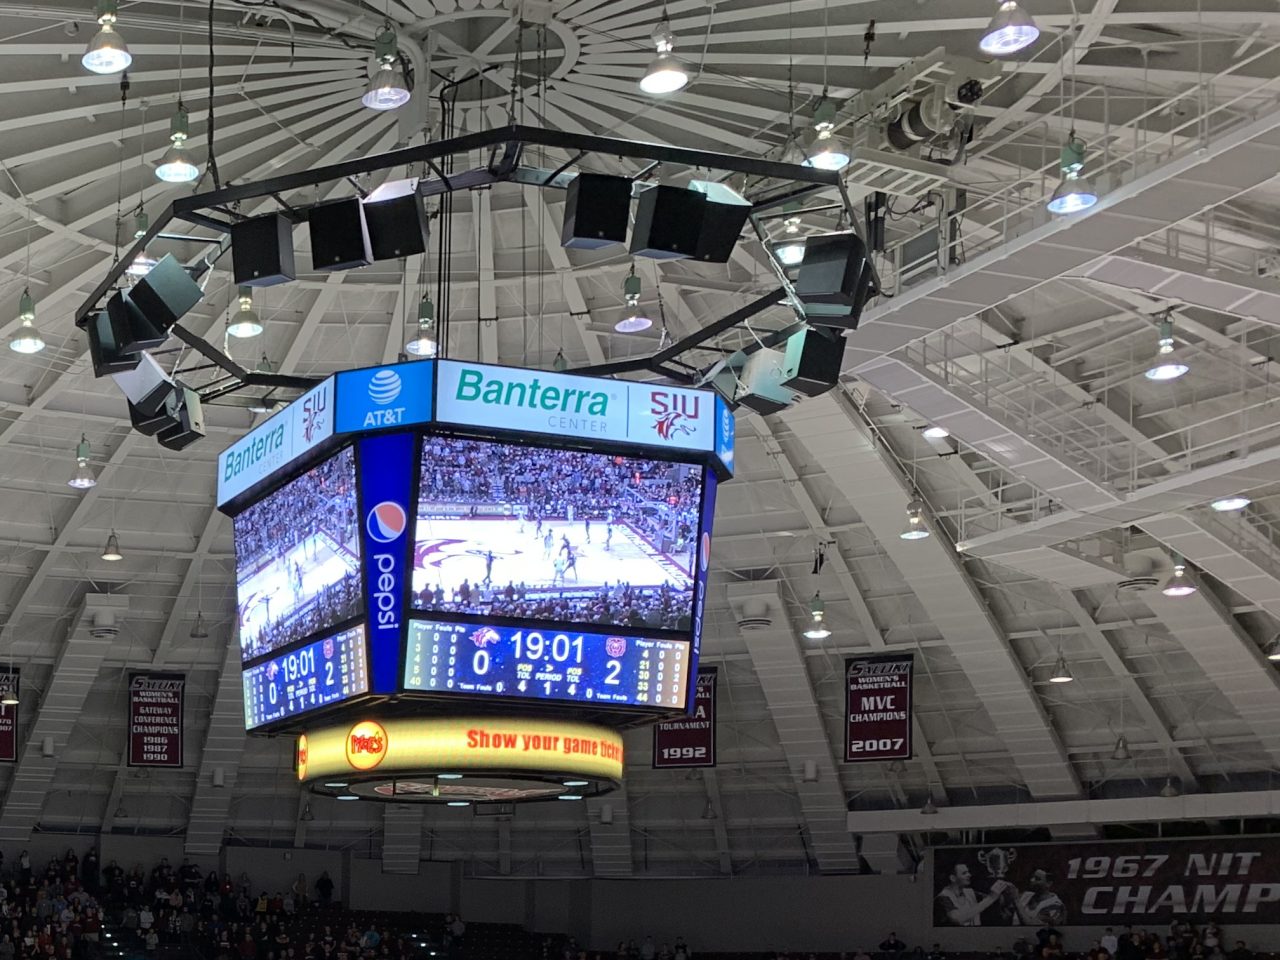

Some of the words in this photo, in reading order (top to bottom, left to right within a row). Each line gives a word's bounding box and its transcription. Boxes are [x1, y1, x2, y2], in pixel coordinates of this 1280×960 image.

[303, 386, 327, 414] SIU
[456, 368, 609, 417] Banterra
[650, 391, 699, 419] SIU
[363, 408, 407, 428] AT&T
[547, 416, 608, 433] CENTER
[224, 424, 284, 483] Banterra
[373, 554, 399, 630] pepsi
[510, 631, 584, 663] 19:01
[635, 640, 654, 648] Player
[282, 647, 315, 683] 19:01
[473, 650, 489, 675] 0
[325, 661, 334, 686] 2
[535, 672, 562, 682] PERIOD
[604, 660, 621, 685] 2
[858, 675, 899, 683] WOMEN'S
[269, 682, 277, 705] 0
[517, 680, 526, 692] 4
[567, 684, 576, 695] 4
[850, 681, 907, 690] BASKETBALL
[139, 706, 172, 714] GATEWAY
[861, 695, 895, 710] MVC
[134, 715, 177, 724] CONFERENCE
[850, 711, 906, 722] CHAMPIONS
[133, 725, 179, 734] CHAMPIONS
[660, 721, 710, 730] TOURNAMENT
[467, 729, 517, 748] Show
[522, 734, 560, 751] your
[563, 737, 598, 756] game
[851, 738, 904, 752] 2007
[143, 753, 168, 761] 1990
[662, 746, 706, 759] 1992
[1067, 854, 1169, 879] 1967
[1184, 852, 1261, 876] NIT
